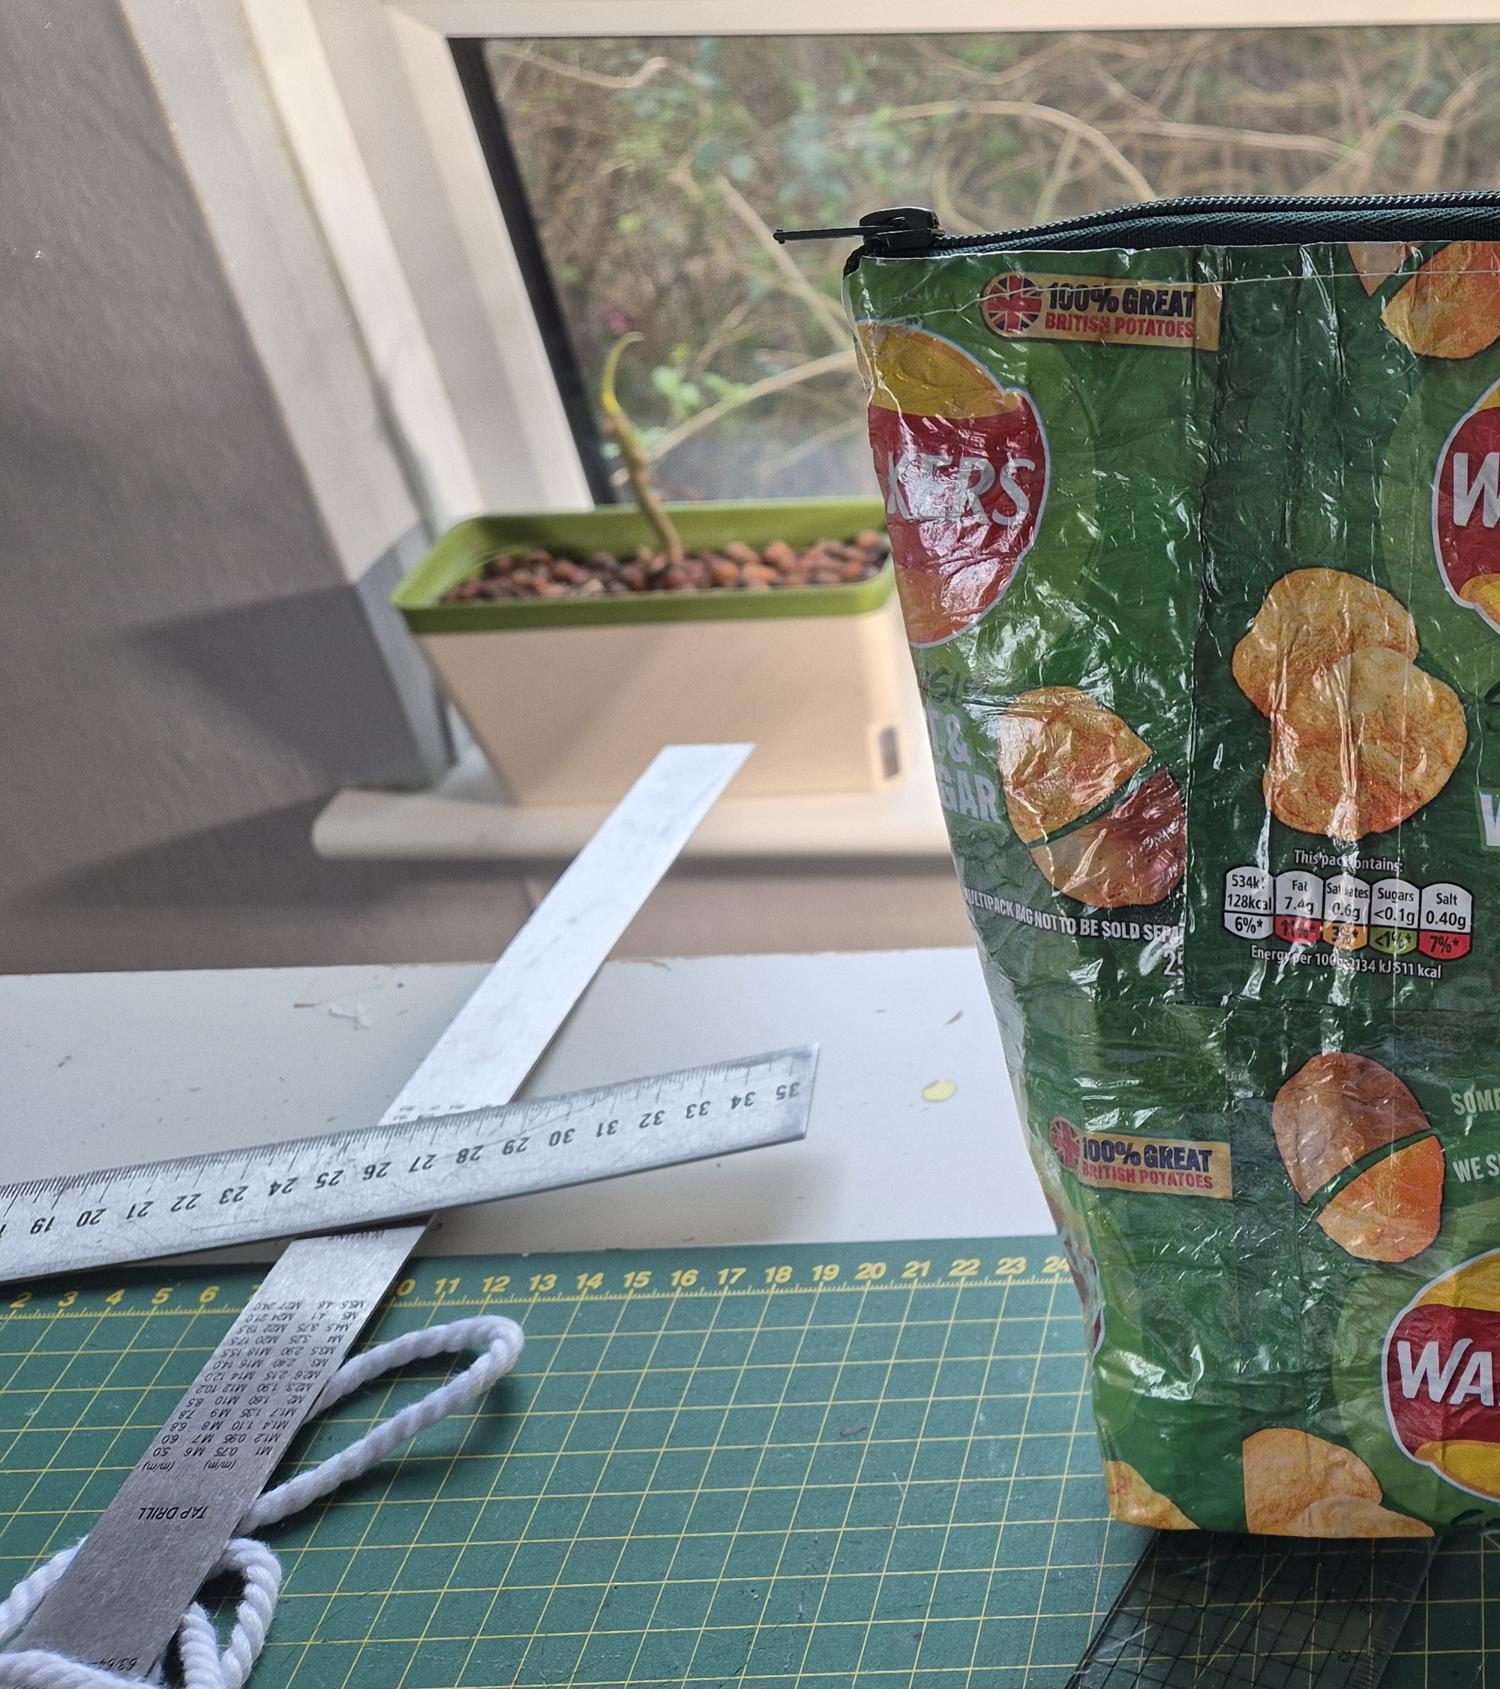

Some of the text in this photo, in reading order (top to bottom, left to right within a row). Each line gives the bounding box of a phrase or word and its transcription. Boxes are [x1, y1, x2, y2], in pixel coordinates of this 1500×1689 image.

[1050, 282, 1196, 317] 100% GREAT
[1045, 312, 1195, 338] BRITISH POTATOES
[1294, 850, 1319, 864] This
[1377, 887, 1415, 903] Sugars
[1435, 892, 1458, 906] Salt
[1015, 903, 1141, 940] BAG NOT TO BE SOLD
[1374, 906, 1415, 926] <0.1g
[1426, 910, 1467, 930] 0.40g
[1418, 964, 1441, 979] kcal
[30, 1081, 800, 1235] 35 34 33 32 31 30 29 28 27 26 25 24 23 22 21 20 19
[1082, 1136, 1213, 1173] 100% GREAT
[1082, 1161, 1214, 1189] BRITISH POTATOES
[1453, 1157, 1485, 1184] WE
[10, 1292, 32, 1308] 2
[59, 1290, 79, 1308] 3
[106, 1288, 125, 1306] 4
[152, 1287, 174, 1304] 5
[200, 1286, 220, 1303] 6
[434, 1277, 461, 1294] 11
[481, 1275, 511, 1293] 12
[528, 1274, 558, 1291] 13
[576, 1272, 604, 1290] 14
[623, 1270, 652, 1288] 15
[671, 1269, 698, 1286] 16
[718, 1267, 747, 1284] 17
[765, 1265, 793, 1283] 18
[812, 1263, 840, 1281] 19
[855, 1262, 887, 1279] 20
[902, 1260, 930, 1278] 21
[948, 1258, 980, 1276] 22
[995, 1257, 1027, 1275] 23
[142, 1460, 236, 1471] (m/m) (m/m)
[138, 1507, 208, 1520] TAP DRILL
